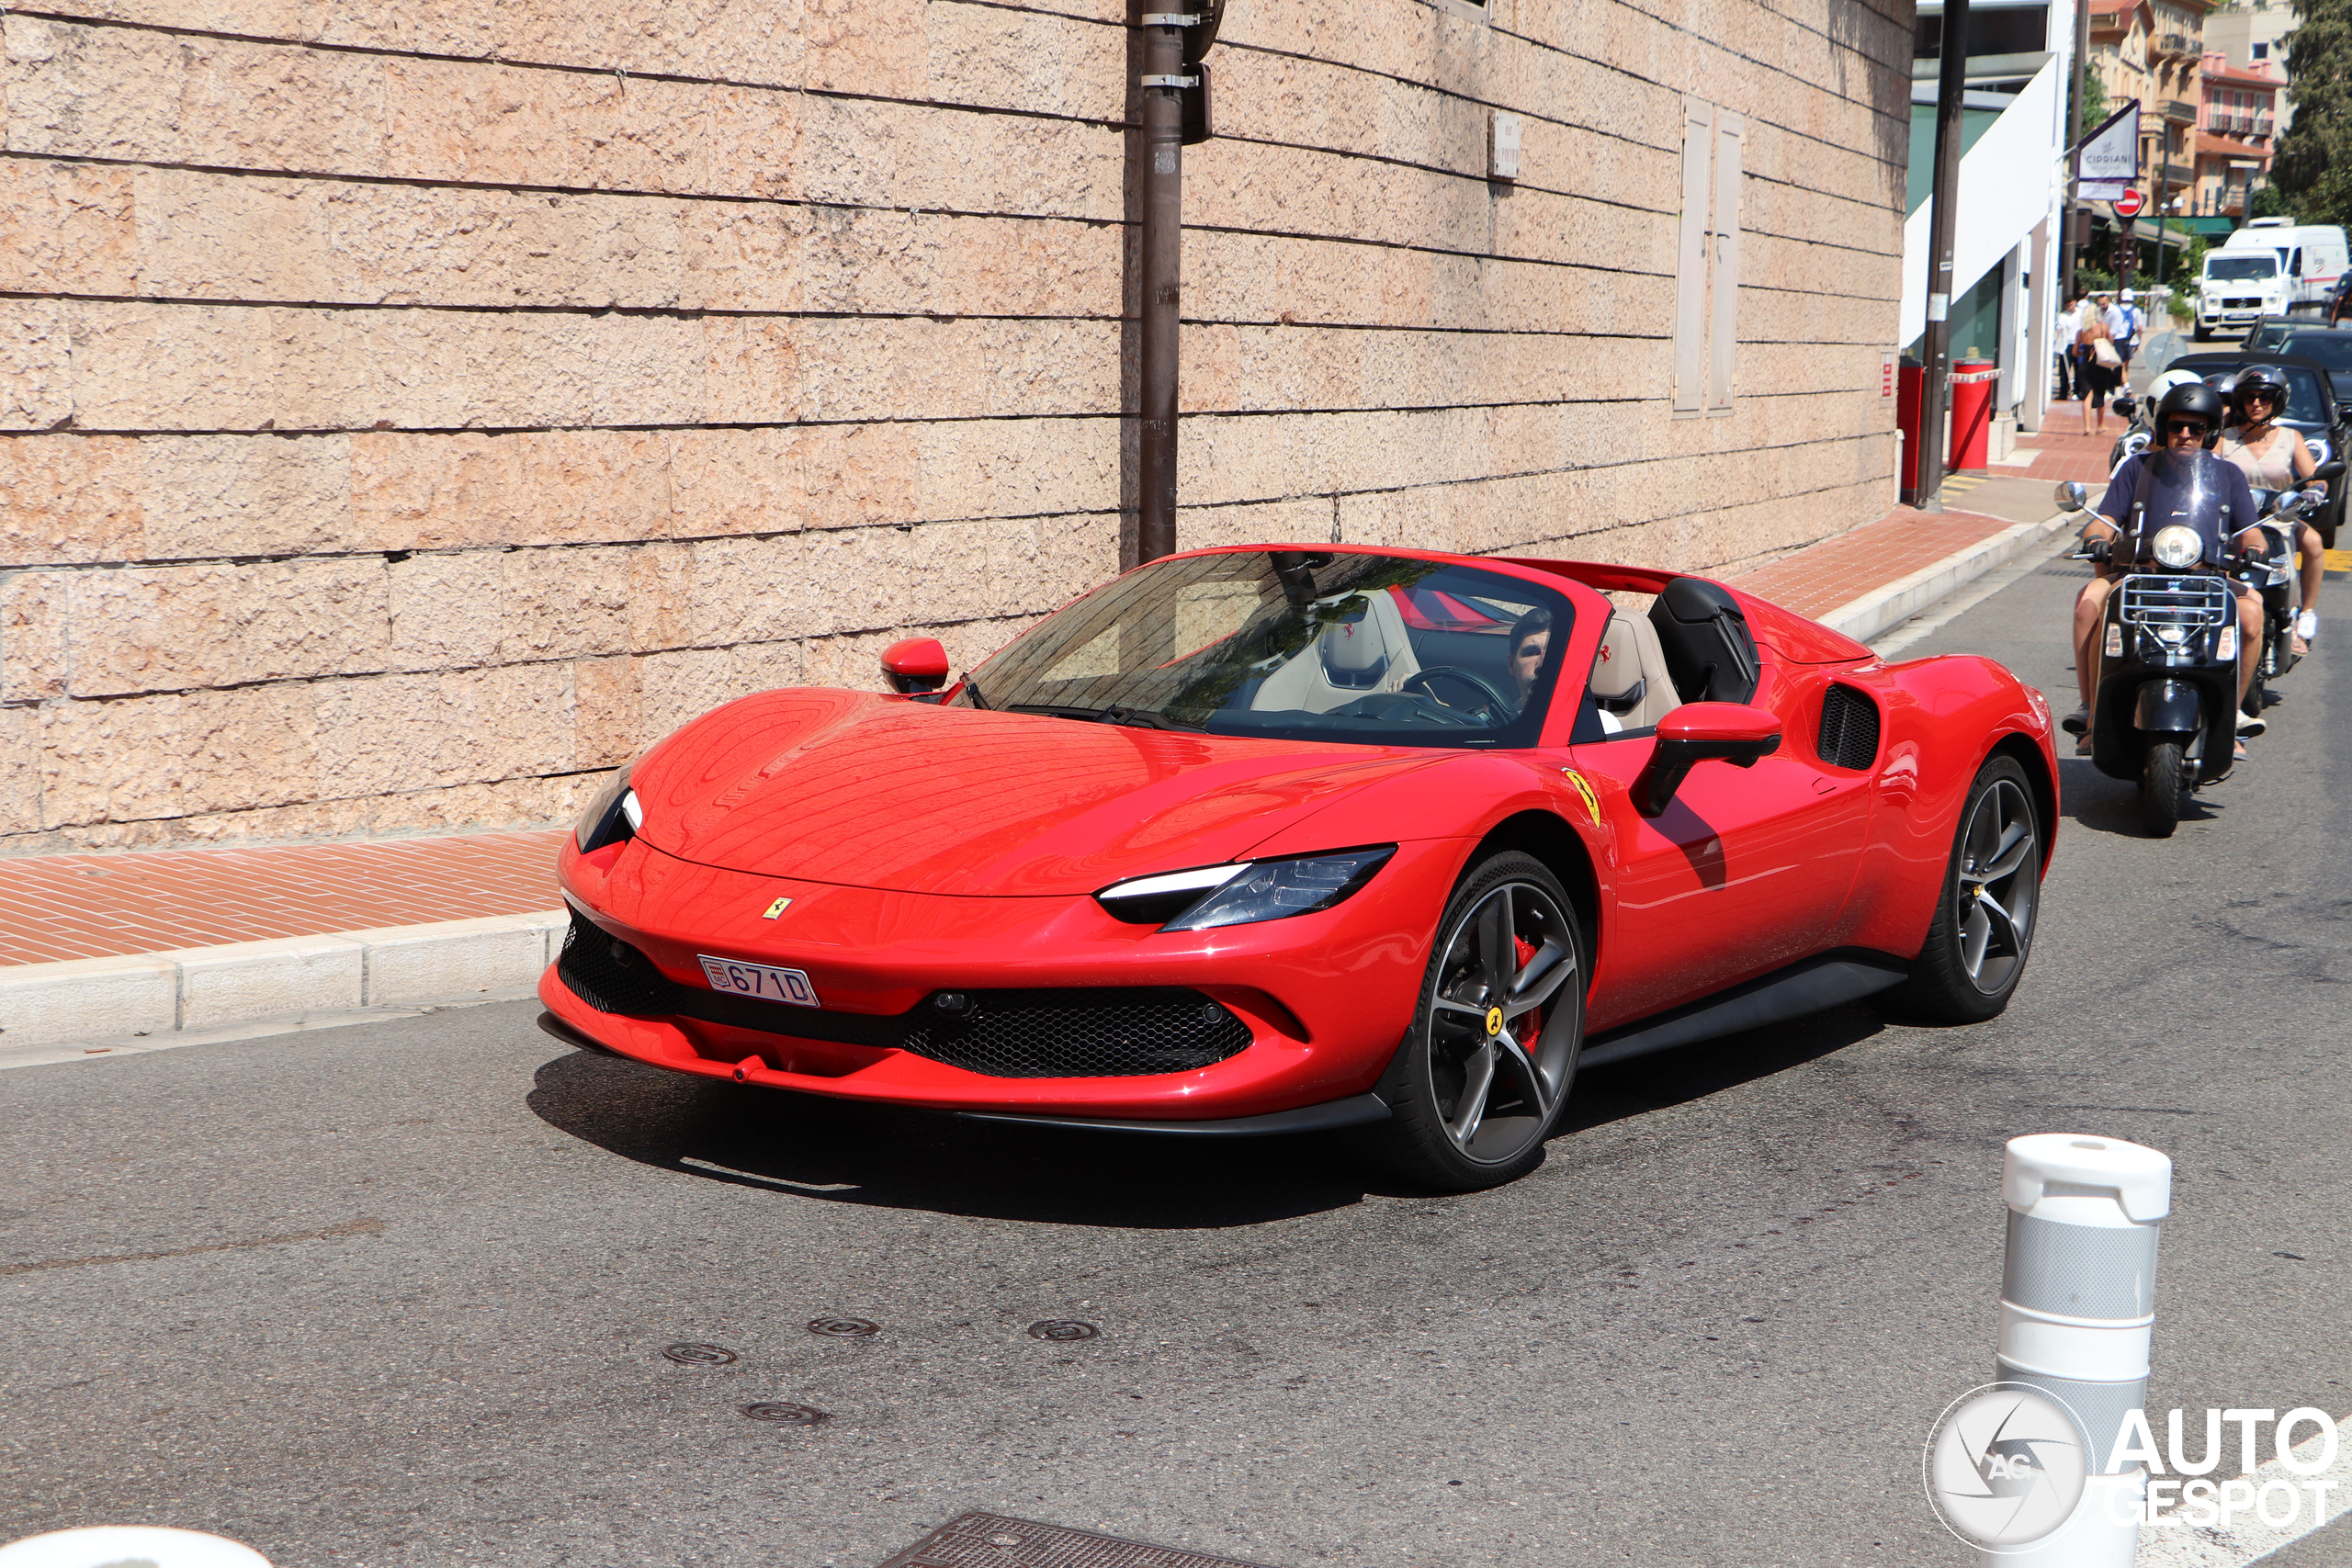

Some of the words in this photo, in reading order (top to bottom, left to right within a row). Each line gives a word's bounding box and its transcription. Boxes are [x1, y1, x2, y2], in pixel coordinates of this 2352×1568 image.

[2086, 154, 2131, 164] CIPRIANI
[1978, 761, 2009, 786] MICHELIN
[713, 975, 728, 984] MC
[729, 965, 808, 1001] 671D
[1417, 942, 1442, 1020] MICHELIN
